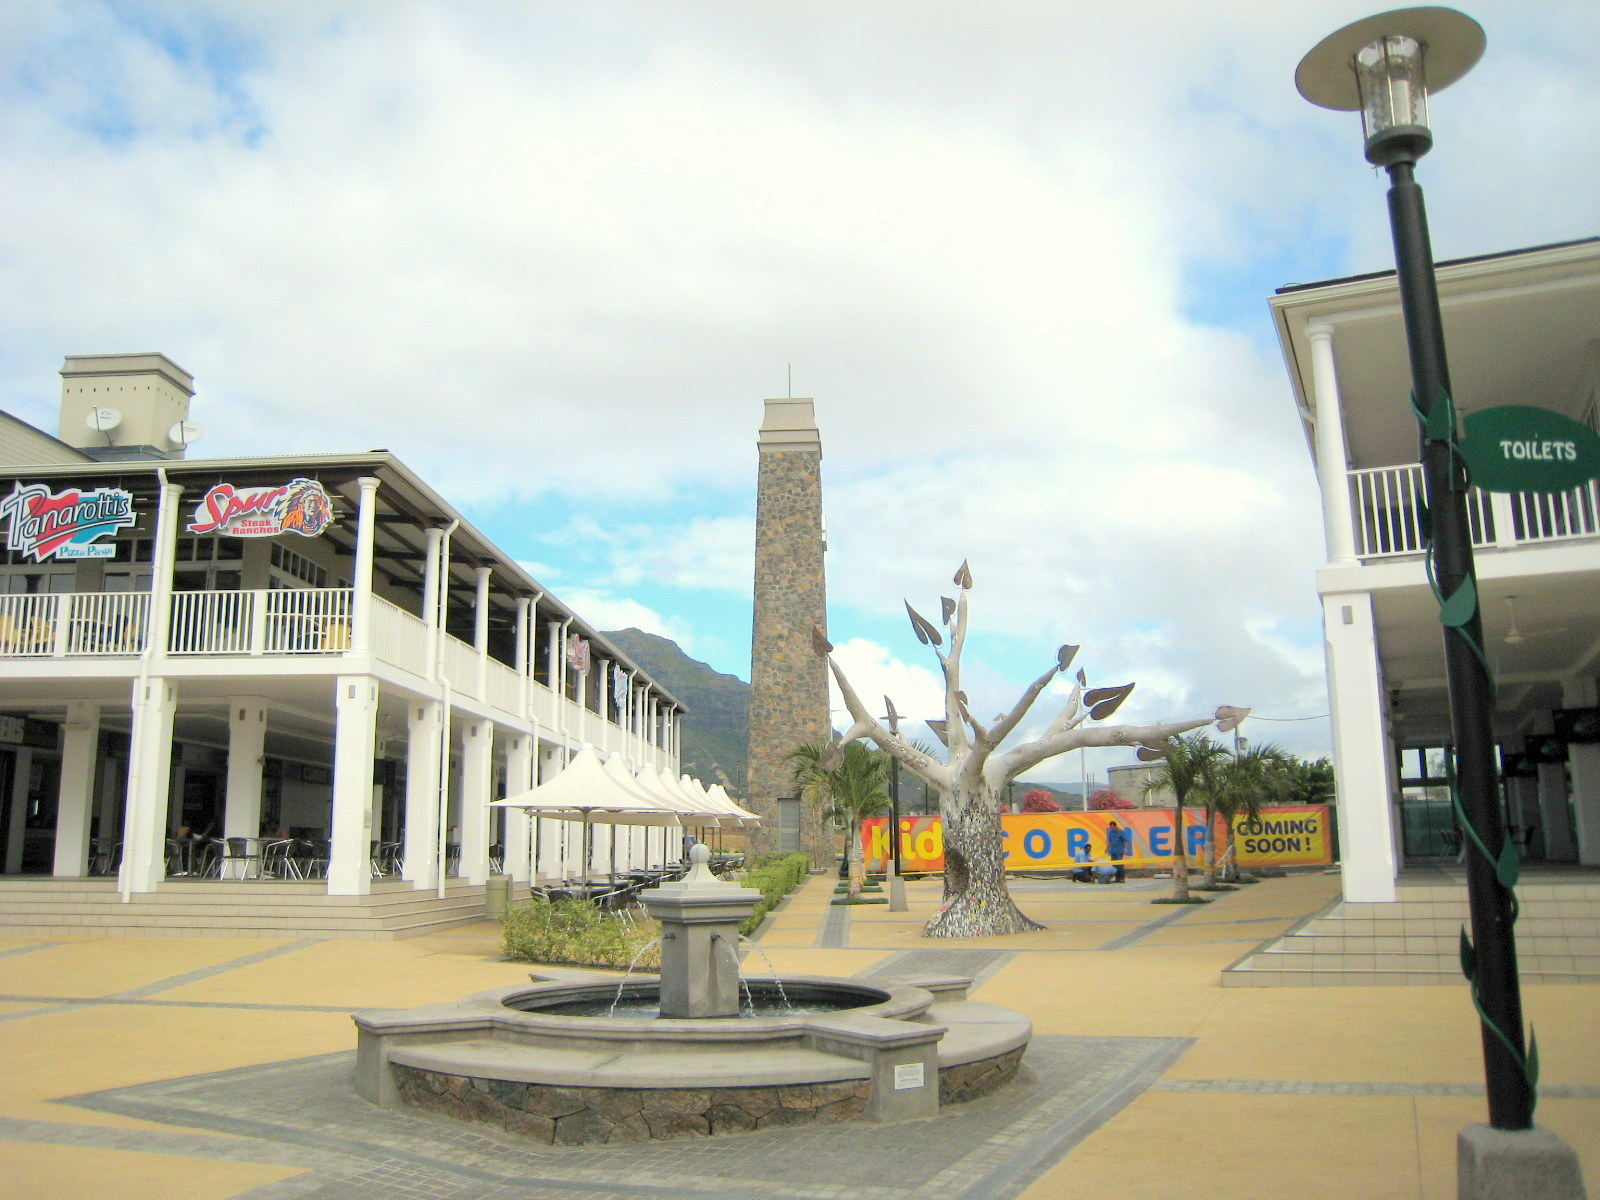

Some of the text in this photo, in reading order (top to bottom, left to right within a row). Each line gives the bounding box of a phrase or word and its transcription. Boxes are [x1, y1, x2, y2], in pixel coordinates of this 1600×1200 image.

[1499, 440, 1577, 460] TOILETS
[3, 488, 129, 548] Panarottis
[190, 484, 288, 532] Spur
[232, 527, 279, 535] Ranches
[1236, 819, 1318, 837] COMING
